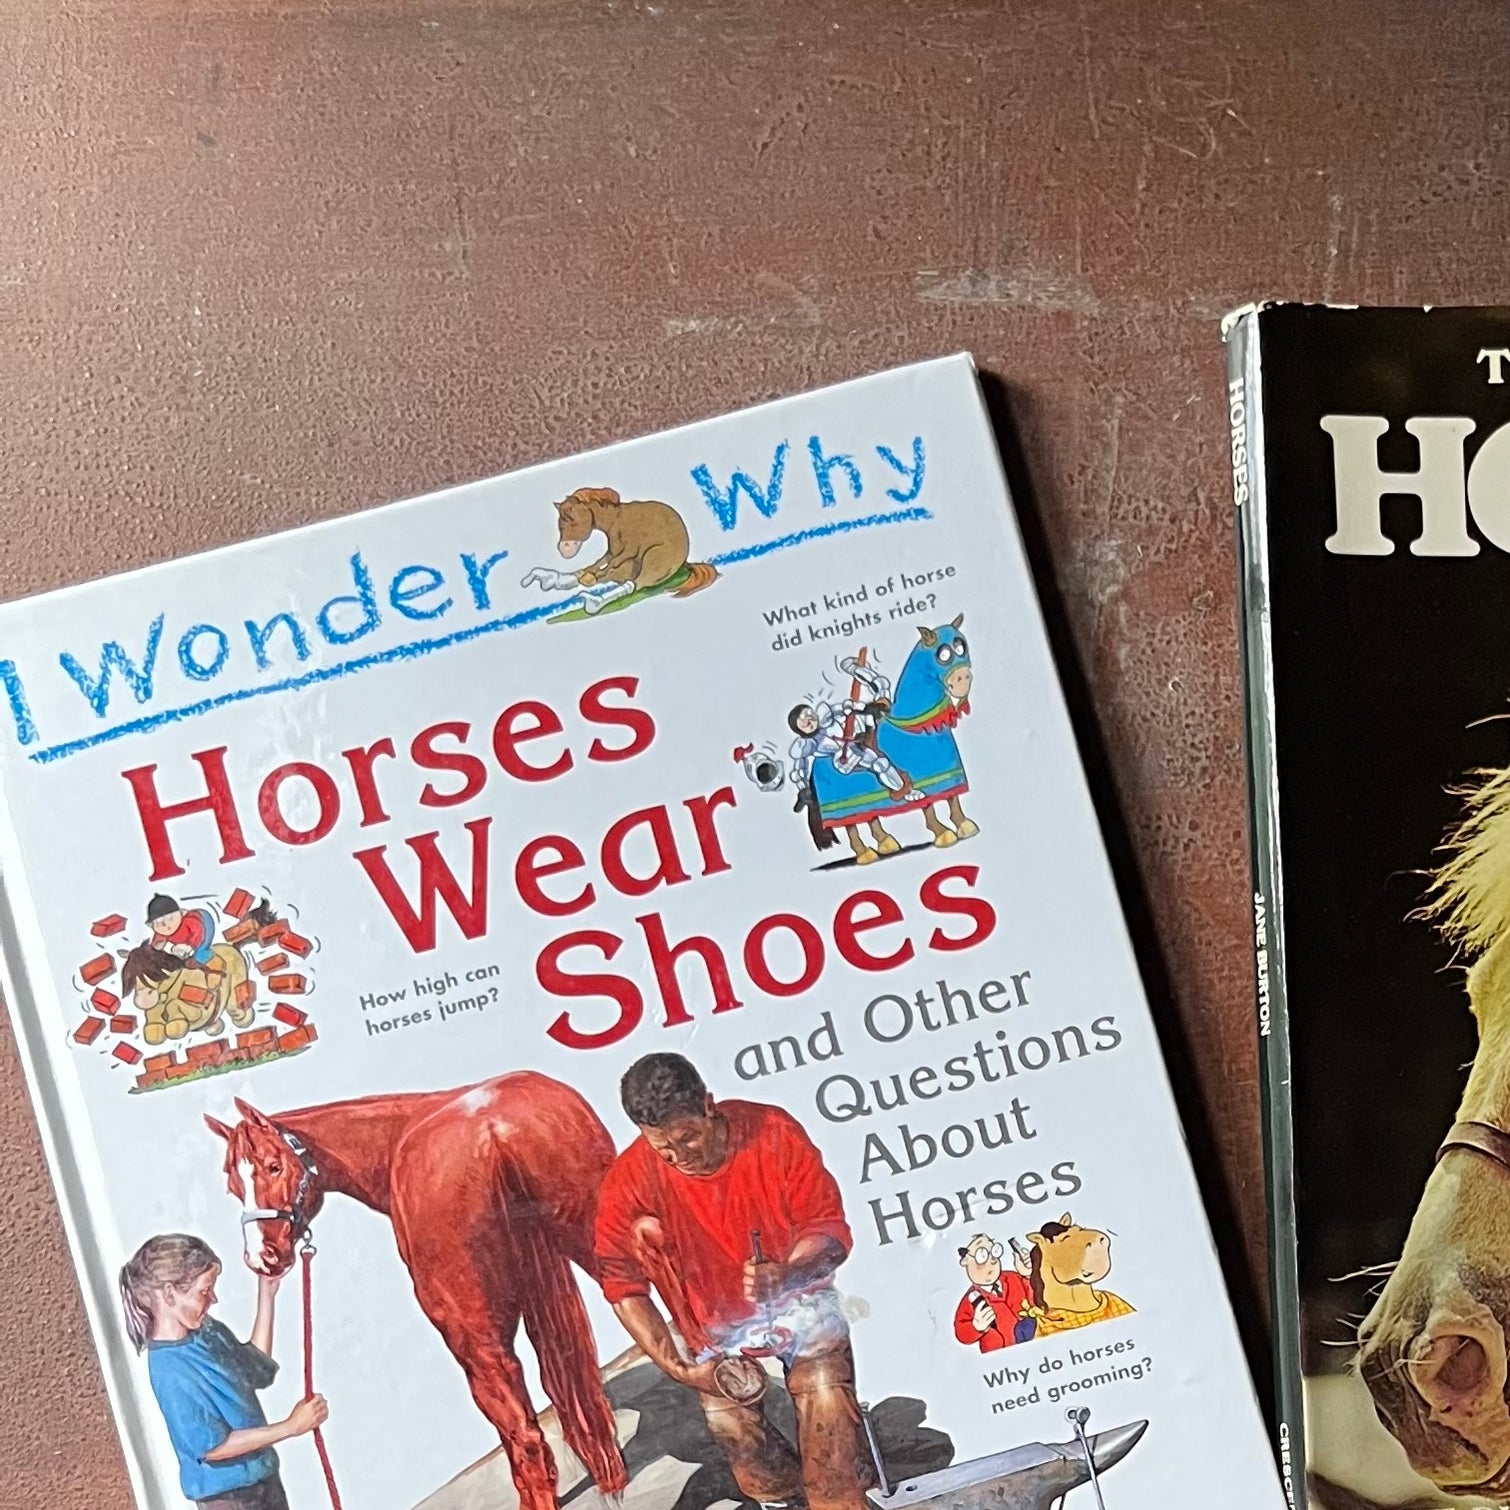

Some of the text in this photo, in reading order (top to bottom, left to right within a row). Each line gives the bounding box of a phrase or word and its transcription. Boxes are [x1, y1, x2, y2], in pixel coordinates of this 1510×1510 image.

[1229, 377, 1249, 506] HORSES
[60, 544, 509, 718] Wonder
[690, 435, 926, 532] Why
[763, 565, 956, 627] What kind of horse
[771, 593, 936, 651] did knights ride?
[121, 675, 656, 882] Horses
[354, 785, 738, 954] Wear
[359, 964, 500, 1011] How high can
[535, 864, 997, 1050] Shoes
[1254, 892, 1271, 1037] JANE BURTON
[366, 987, 499, 1036] horses jump?
[733, 970, 1031, 1081] and Other
[815, 1014, 1122, 1123] Questions
[858, 1098, 1036, 1183] About
[869, 1161, 1081, 1246] Horses
[983, 1338, 1135, 1388] Why do horses
[992, 1357, 1152, 1414] need grooming?
